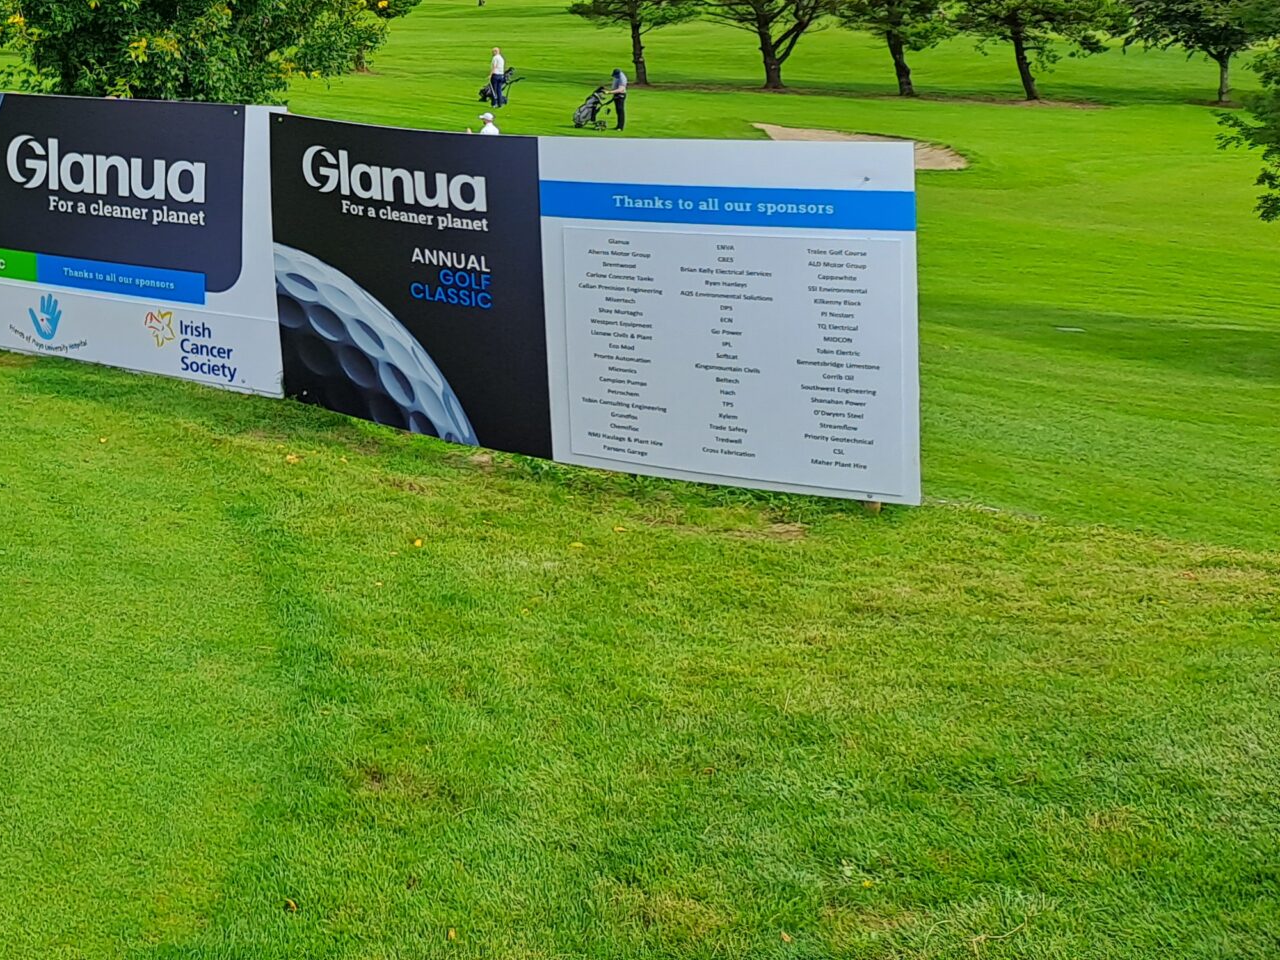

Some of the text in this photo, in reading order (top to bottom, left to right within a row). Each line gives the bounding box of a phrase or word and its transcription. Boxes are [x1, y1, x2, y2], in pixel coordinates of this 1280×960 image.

[6, 134, 206, 203] Glanua
[302, 145, 487, 212] Glanua
[48, 196, 205, 225] For a cleaner planet
[612, 195, 834, 215] Thanks to all our sponsors
[342, 200, 489, 231] For a cleaner planet
[412, 248, 491, 272] ANNUAL
[63, 267, 94, 279] Thanks
[105, 273, 117, 282] all
[119, 275, 133, 284] our
[135, 277, 175, 290] sponsors
[440, 270, 491, 290] GOLF
[411, 282, 492, 308] CLASSIC
[627, 287, 663, 295] Engineering
[180, 320, 211, 339] Irish
[180, 339, 233, 359] Cancer
[181, 356, 237, 382] Society
[801, 384, 876, 396] Southwest Engineering
[632, 403, 667, 413] Engineering
[811, 397, 843, 405] Shanahan
[728, 426, 747, 434] Safety
[804, 434, 874, 445] Priority Geotechnical
[627, 448, 647, 456] Garage
[720, 449, 756, 458] Fabrication
